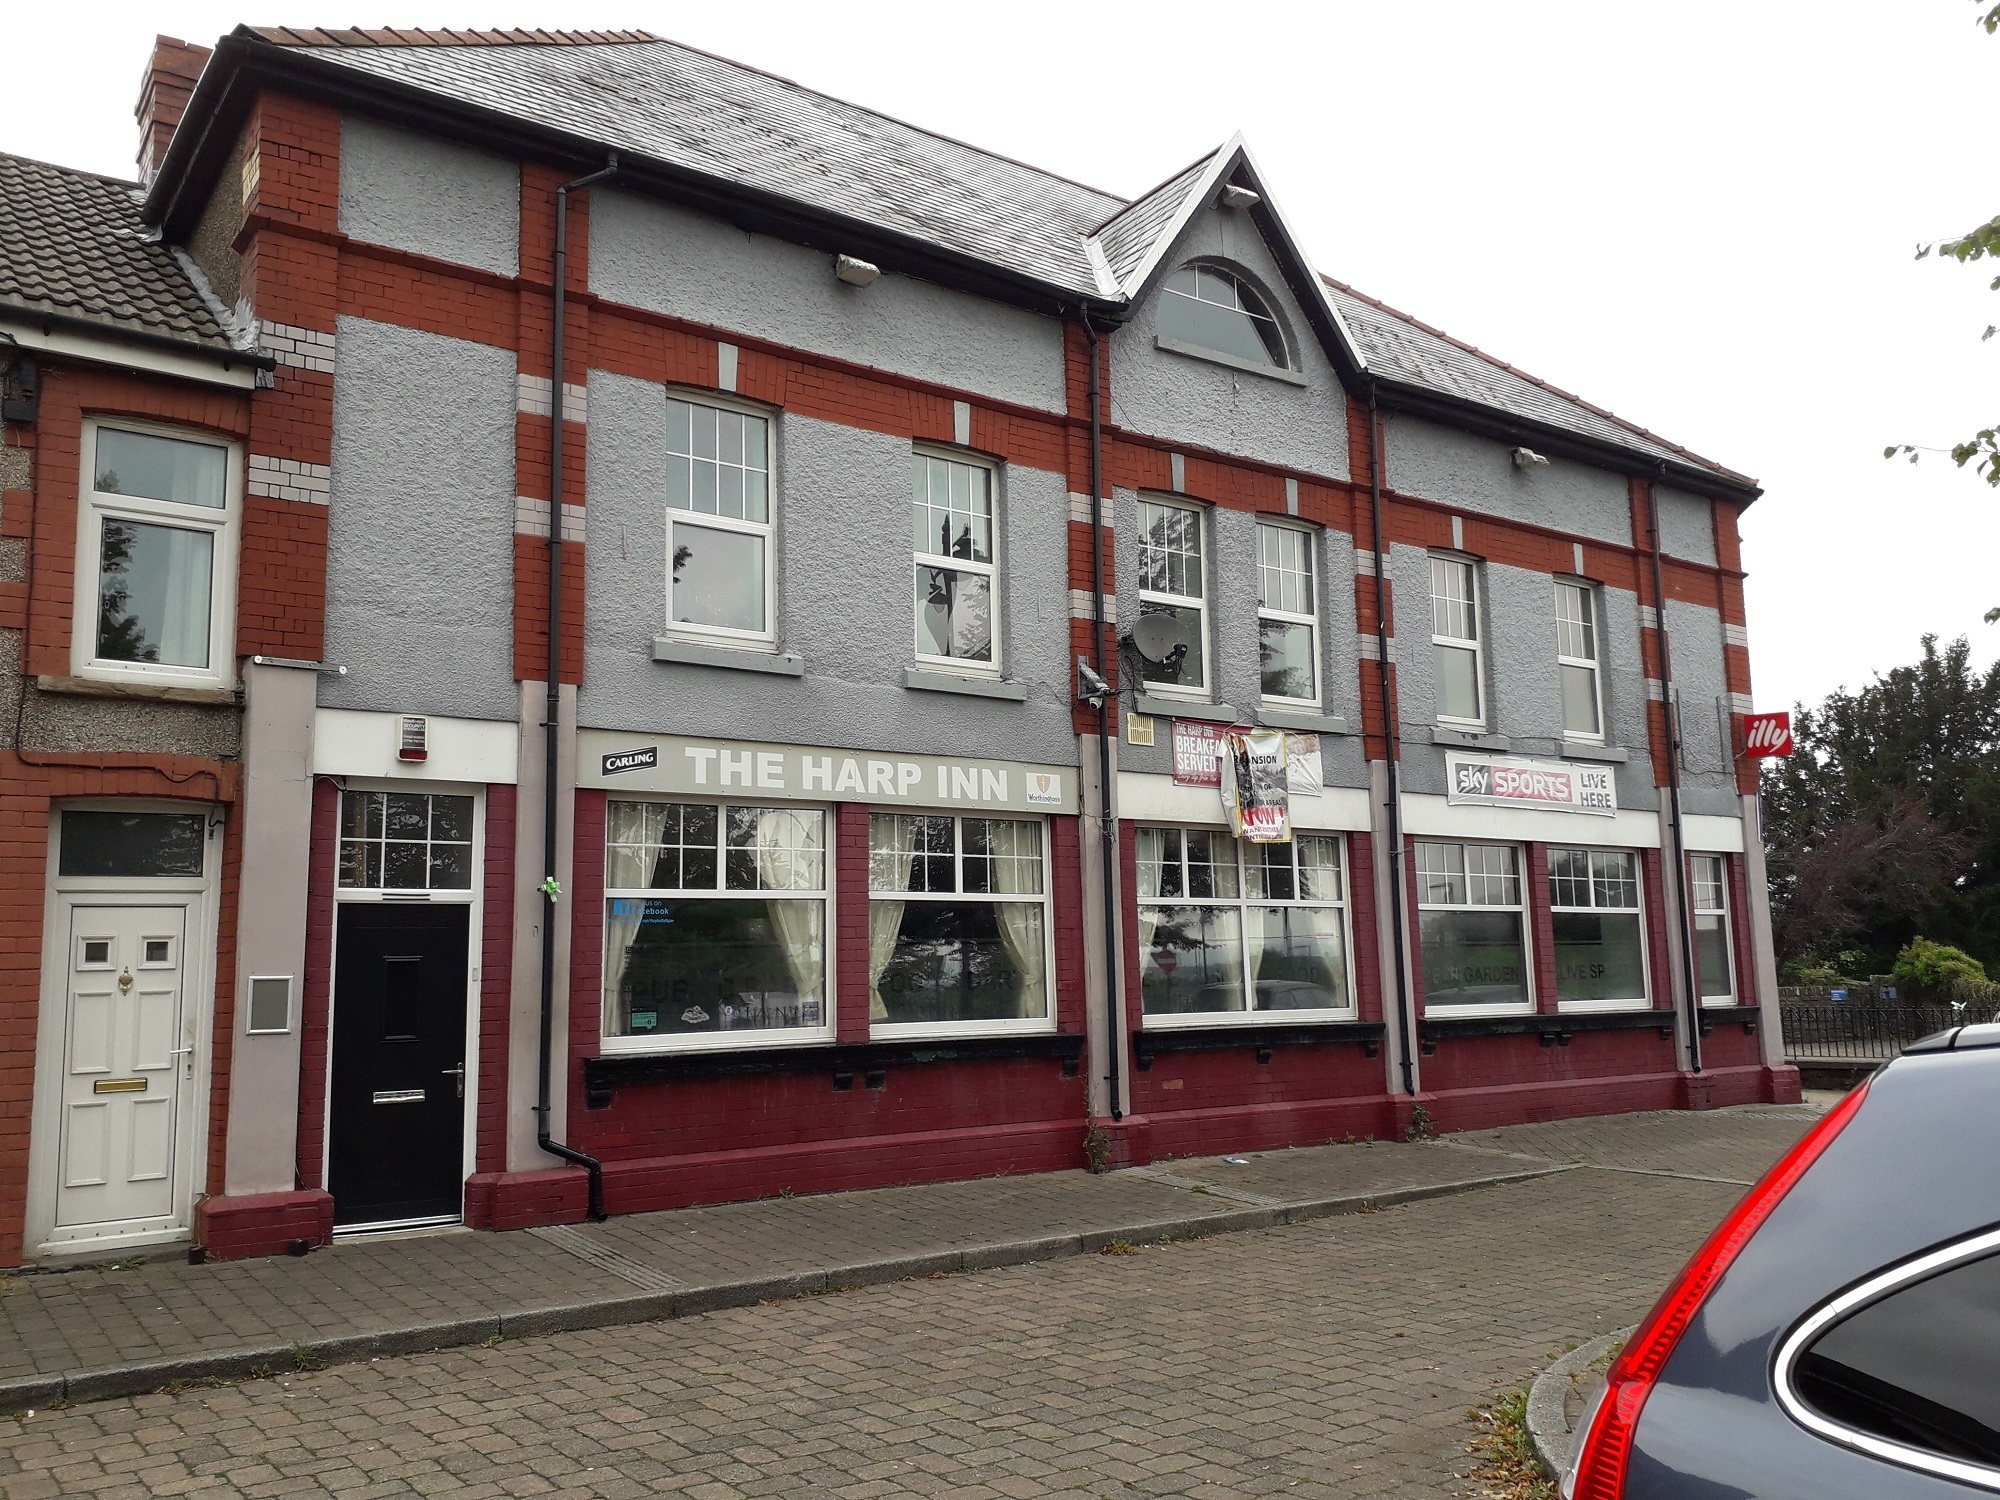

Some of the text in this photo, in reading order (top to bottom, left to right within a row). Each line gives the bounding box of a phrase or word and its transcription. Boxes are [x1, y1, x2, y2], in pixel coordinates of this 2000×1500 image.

[1175, 723, 1187, 734] THE
[1187, 725, 1203, 736] HARP
[1747, 719, 1788, 753] illy
[605, 752, 654, 770] CARLING
[1177, 753, 1216, 772] SERVED
[684, 746, 1008, 802] THE HARP INN
[1459, 766, 1568, 798] sky SPORTS
[1580, 773, 1607, 789] LIVE
[1580, 791, 1612, 808] HERE
[631, 907, 669, 915] Facebook
[1463, 965, 1520, 982] GARDEN
